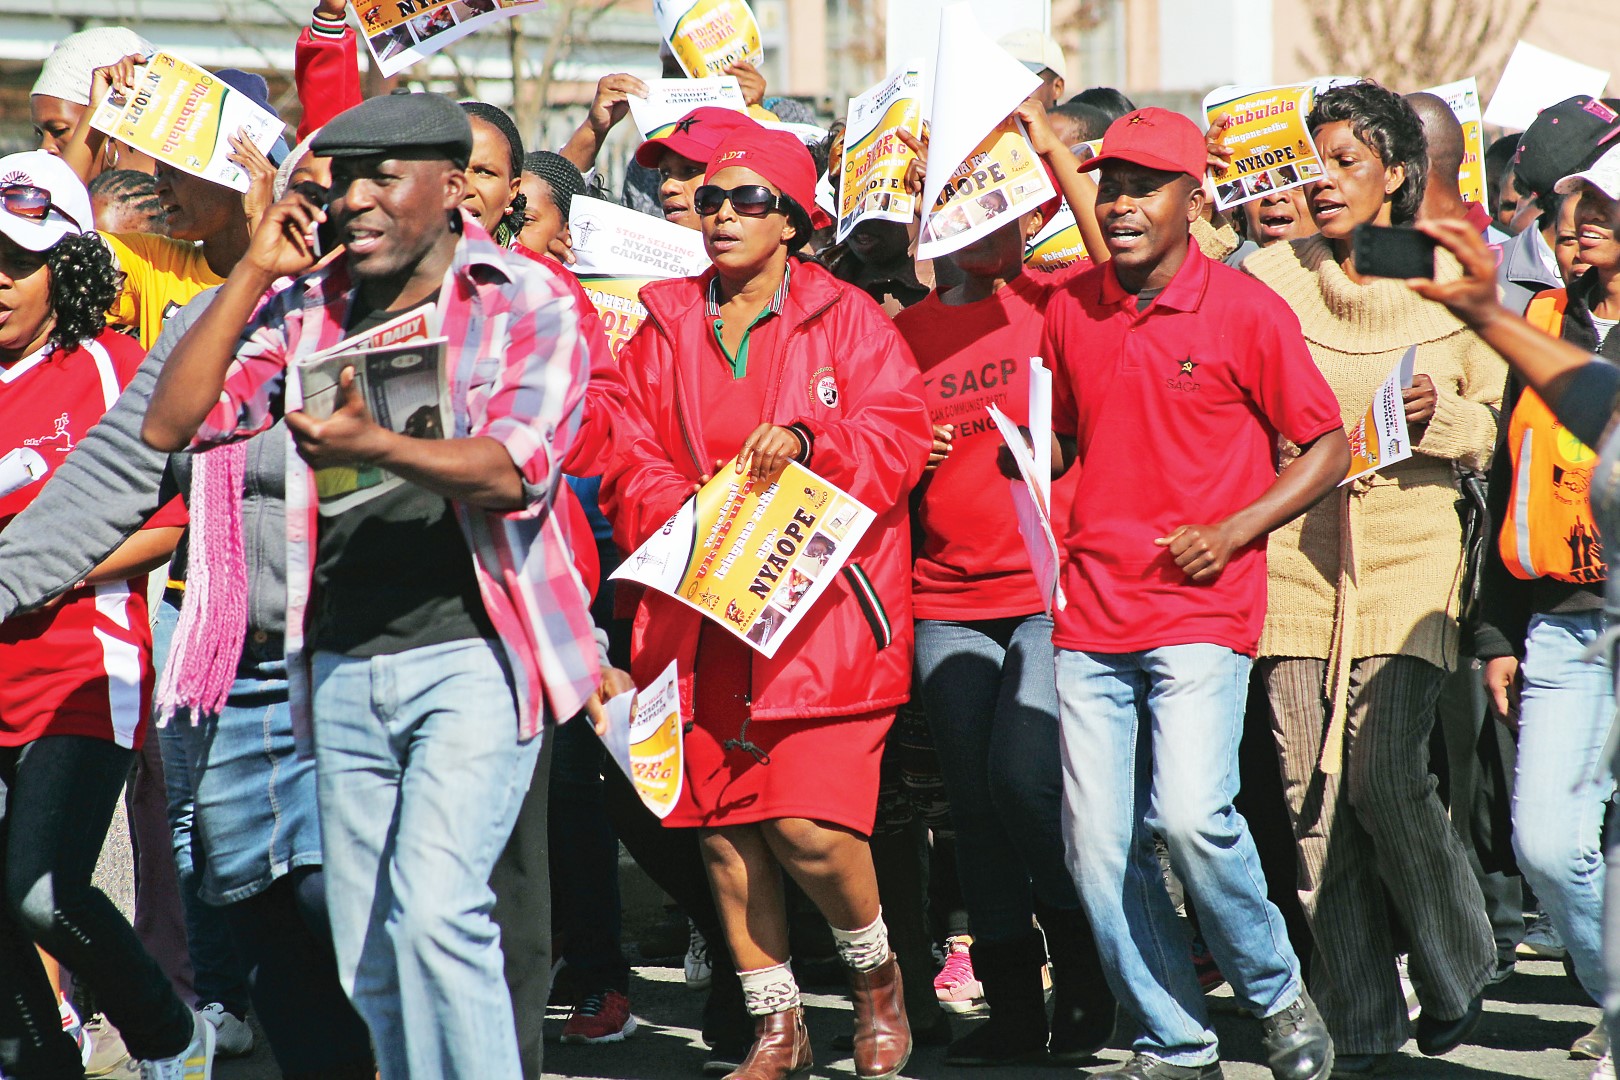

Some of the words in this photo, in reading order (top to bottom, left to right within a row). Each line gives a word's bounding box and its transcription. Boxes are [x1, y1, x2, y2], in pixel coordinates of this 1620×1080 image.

[125, 71, 162, 125] NYAOPE
[665, 96, 718, 104] CAMPAIGN
[162, 82, 209, 154] Ukubulala
[1223, 100, 1295, 131] kubulala
[1011, 161, 1030, 173] SANCO
[1235, 147, 1296, 174] NYAOPE
[616, 227, 645, 241] STOP
[646, 236, 695, 258] SELLING
[622, 238, 683, 264] NYAOPE
[610, 245, 690, 276] CAMPAIGN
[382, 317, 422, 346] DAILY
[940, 358, 1018, 399] SACP
[1166, 378, 1201, 392] SACP
[945, 397, 984, 418] COMMUNIST
[986, 392, 1008, 406] PARTY
[815, 491, 828, 510] SANCO
[696, 470, 754, 580] Ukubula
[748, 505, 817, 601] NYAOPE
[739, 607, 757, 631] COSATU
